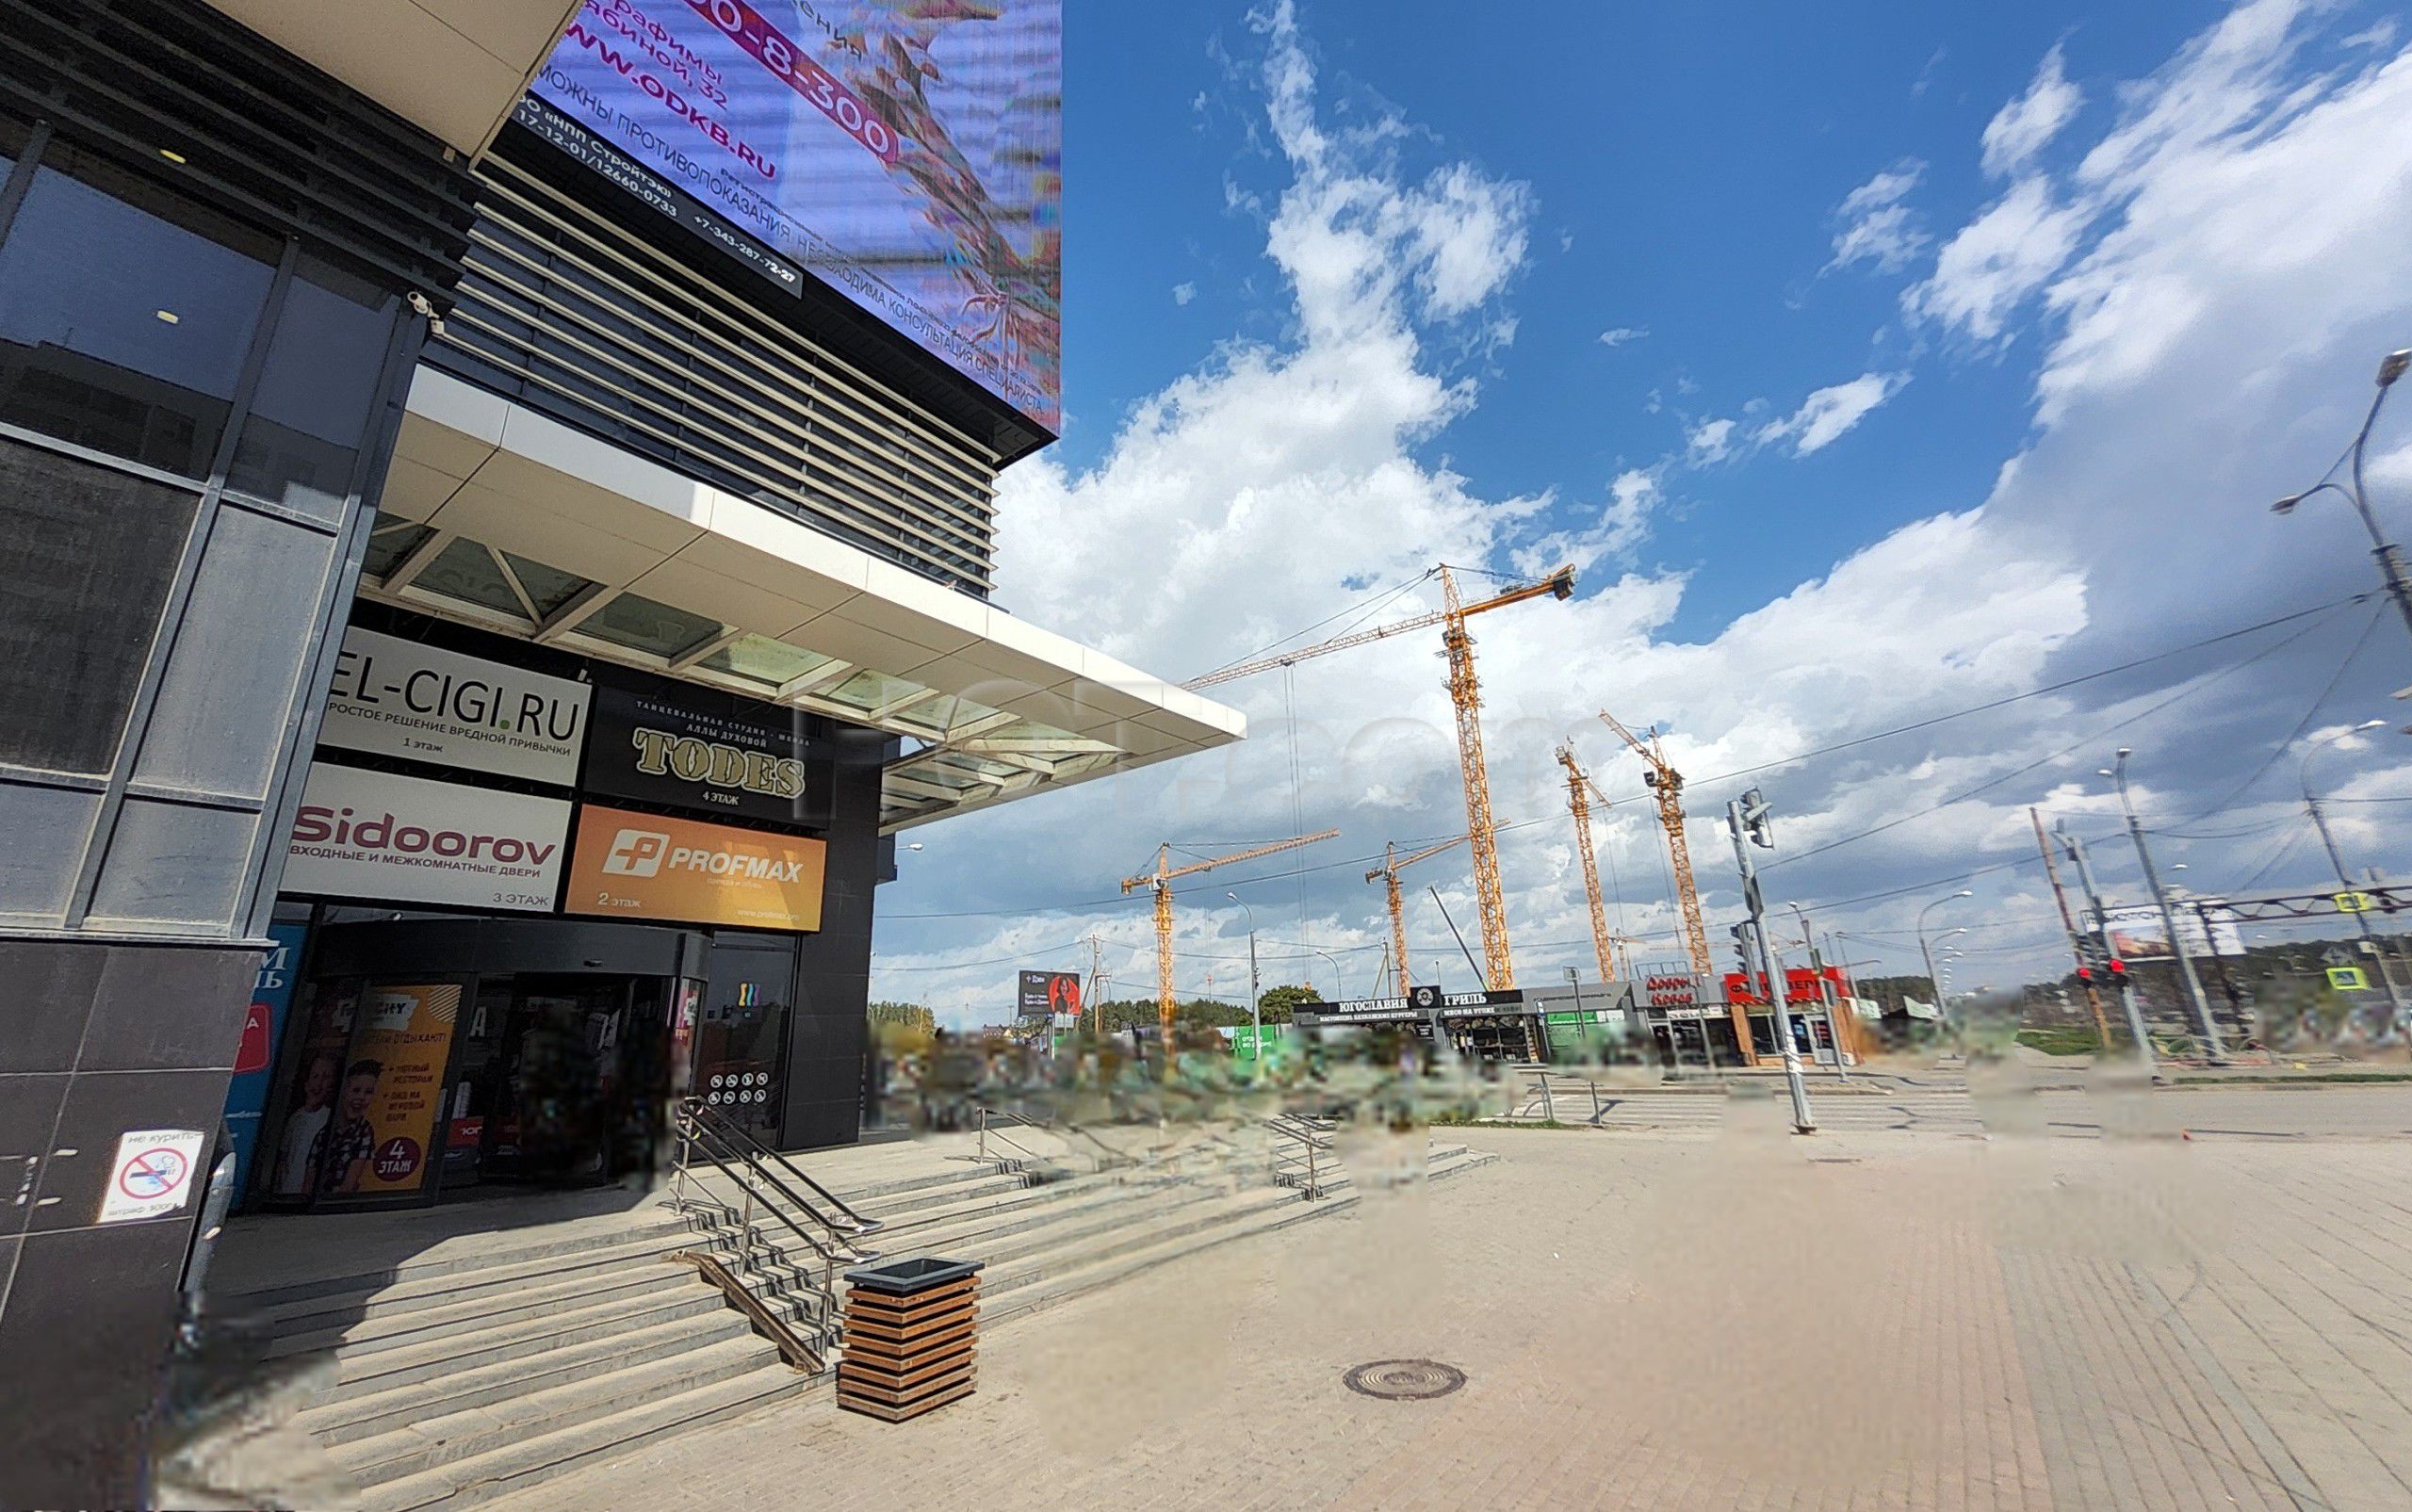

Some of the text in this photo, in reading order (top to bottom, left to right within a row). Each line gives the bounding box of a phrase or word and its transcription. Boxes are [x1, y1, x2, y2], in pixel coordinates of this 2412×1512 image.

[691, 0, 888, 154] 0-8-300
[699, 77, 728, 111] 32
[519, 109, 678, 218] 17-12-01/12660-0733
[383, 713, 447, 735] РЕШЕНИЕ
[449, 725, 507, 745] ВРЕДНОЙ
[509, 737, 572, 757] ПРИВЫЧКИ
[402, 737, 445, 754] 1 этаж
[686, 723, 768, 749] АЛЛЫ ДУХОВОЙ
[632, 726, 807, 800] TODES
[701, 790, 741, 806] 4 ЭТАЖ
[291, 806, 556, 866] Sidoorov
[289, 844, 541, 878] ВХОДНЫЕ И МЕЖКОМНАТНЫЕ ДВЕРИ
[668, 847, 804, 884] PROFMAX
[492, 892, 549, 906] 3 ЭТАЖ
[597, 892, 642, 908] 2 этаж
[1338, 993, 1487, 1013] ЮГОСЛАВИЯ ГРИЛЬ
[389, 1140, 406, 1160] 4
[378, 1160, 413, 1175] ЭТАЖ
